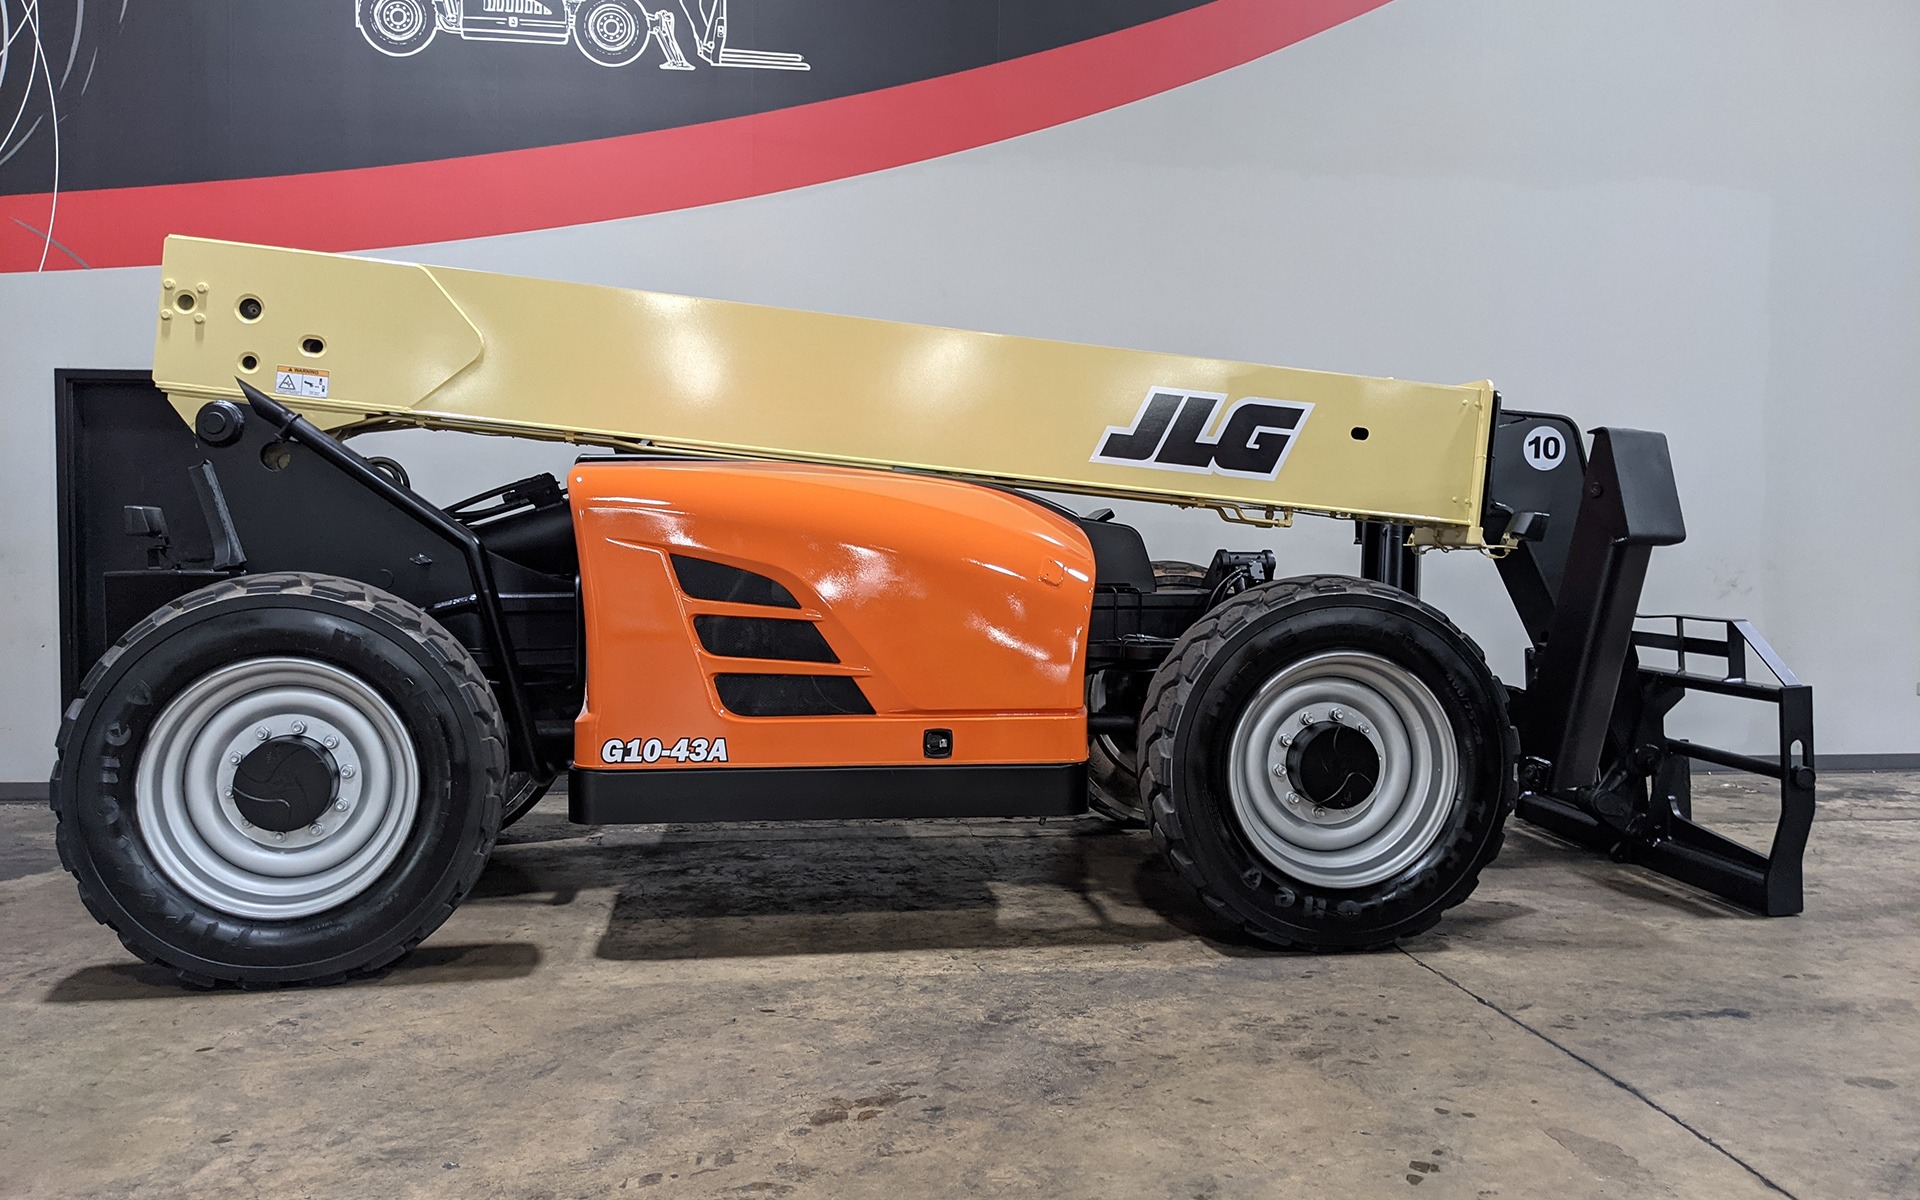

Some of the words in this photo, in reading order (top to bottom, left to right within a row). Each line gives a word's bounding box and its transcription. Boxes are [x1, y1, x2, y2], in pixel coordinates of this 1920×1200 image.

[294, 367, 319, 375] WARNING
[1093, 389, 1312, 479] JLG
[1528, 436, 1560, 459] 10
[601, 737, 728, 763] G10-43A
